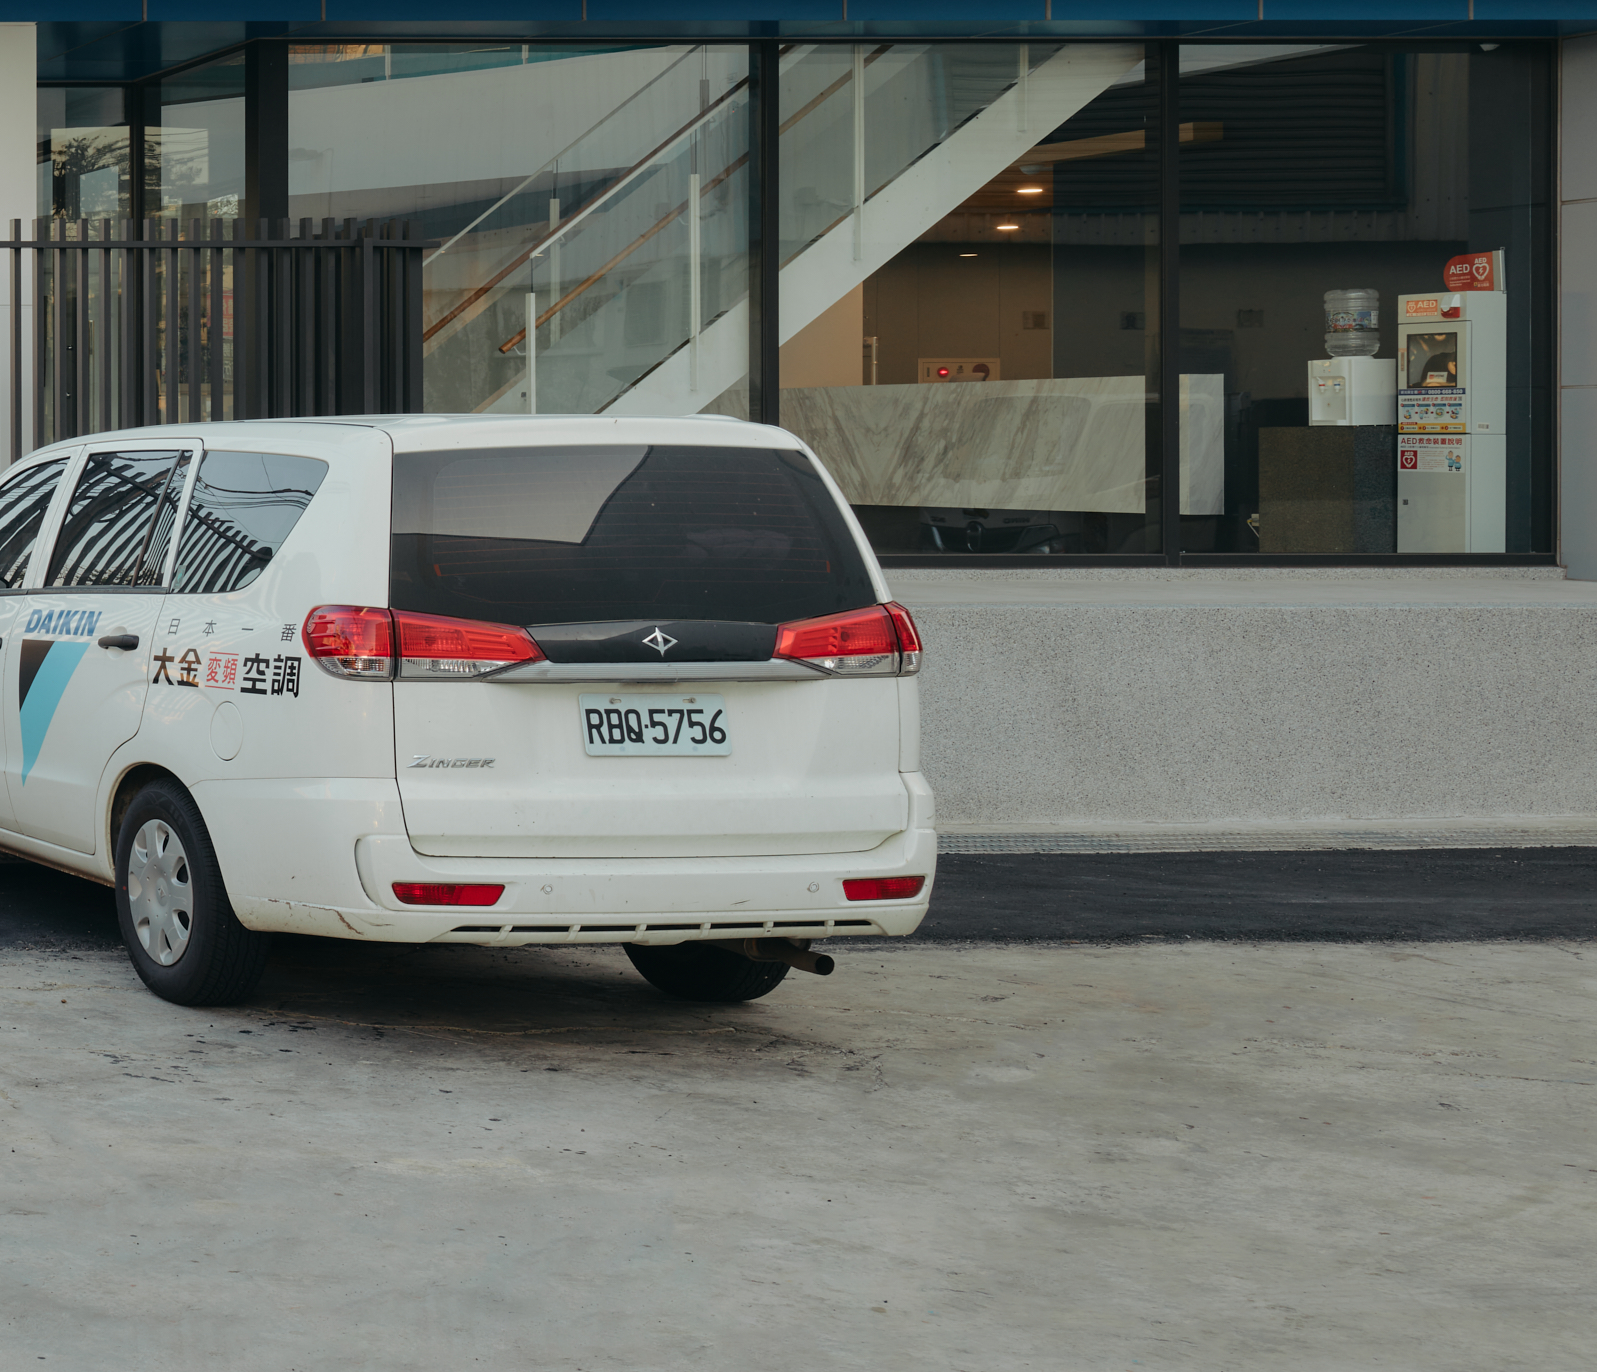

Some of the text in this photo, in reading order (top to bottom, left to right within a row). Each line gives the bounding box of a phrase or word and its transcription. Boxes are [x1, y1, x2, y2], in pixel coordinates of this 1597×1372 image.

[1449, 264, 1470, 275] AED
[1417, 300, 1436, 308] AED
[24, 609, 102, 636] DAIKIN
[167, 618, 297, 642] 日本一番
[585, 708, 727, 744] RBQ-5756
